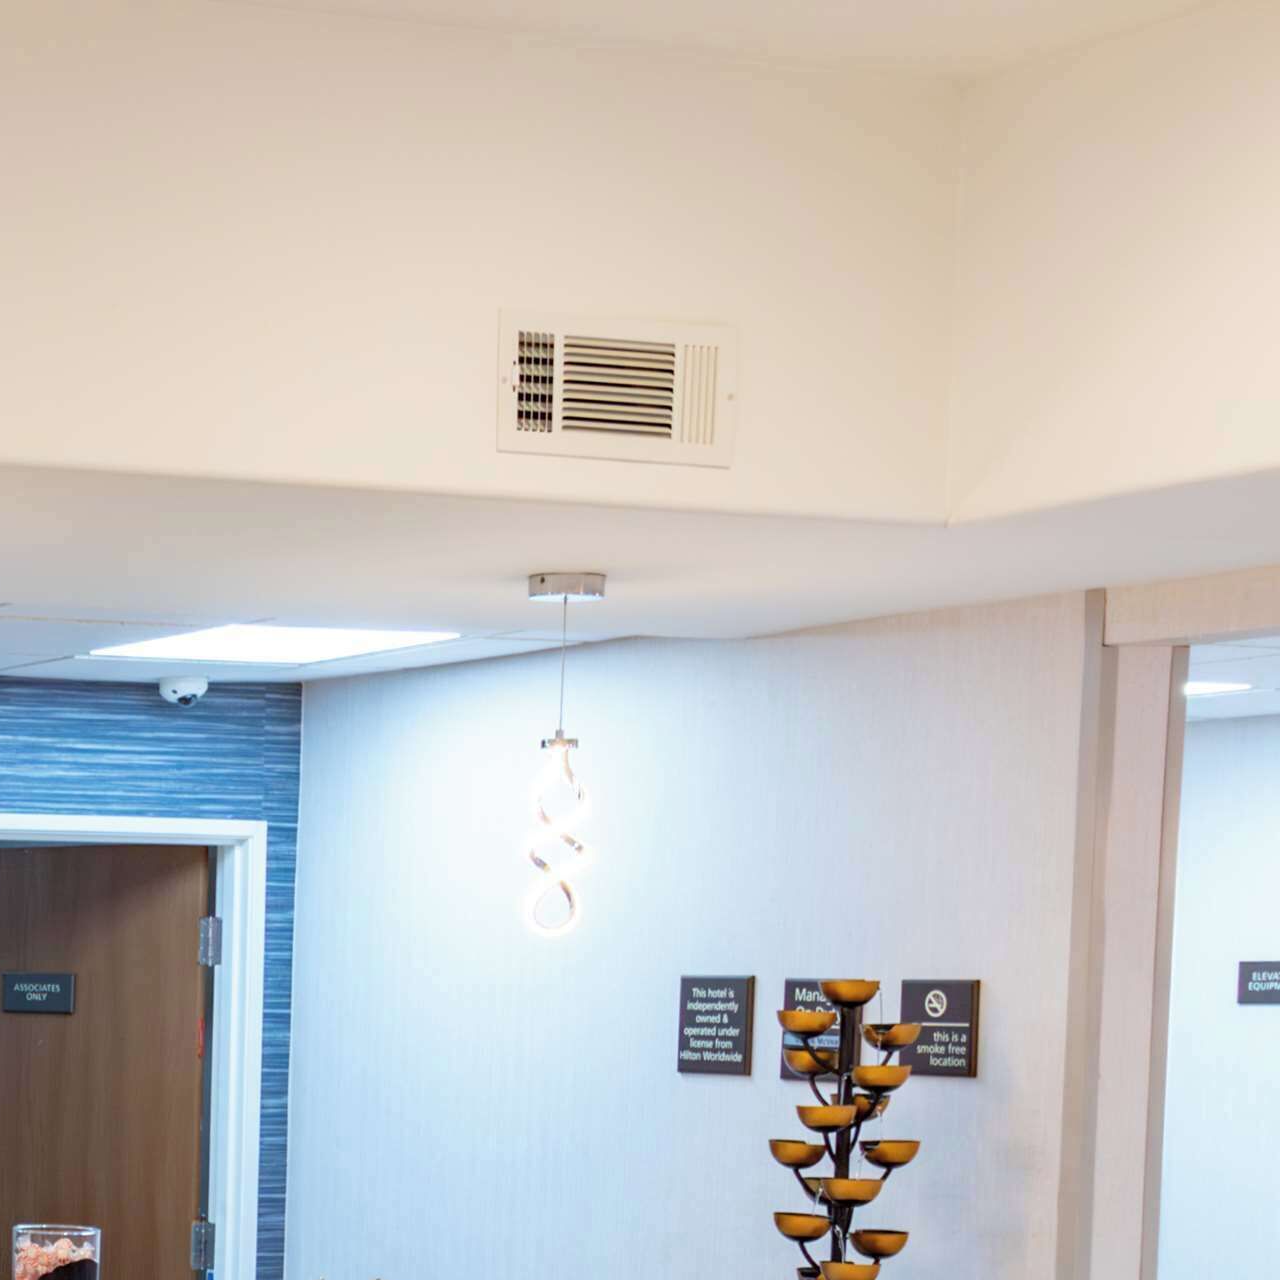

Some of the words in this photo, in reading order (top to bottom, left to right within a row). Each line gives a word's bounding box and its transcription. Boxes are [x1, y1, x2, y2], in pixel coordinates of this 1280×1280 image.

[1252, 971, 1280, 981] ELEVA
[14, 984, 61, 992] ASSOCIATES
[692, 987, 706, 998] This
[707, 987, 727, 998] hotel
[728, 988, 734, 998] is
[26, 992, 48, 1001] ONLY
[687, 1000, 739, 1013] independently
[695, 1013, 720, 1023] owned
[722, 1013, 728, 1023] &
[683, 1026, 716, 1037] operated
[717, 1026, 740, 1036] under
[933, 1031, 949, 1042] this
[951, 1031, 959, 1042] is
[960, 1033, 967, 1043] a
[689, 1037, 713, 1048] license
[715, 1037, 733, 1048] from
[916, 1043, 945, 1054] smoke
[948, 1042, 967, 1055] free
[680, 1050, 701, 1060] Hilton
[702, 1051, 743, 1062] Worldwide
[929, 1055, 966, 1067] location
